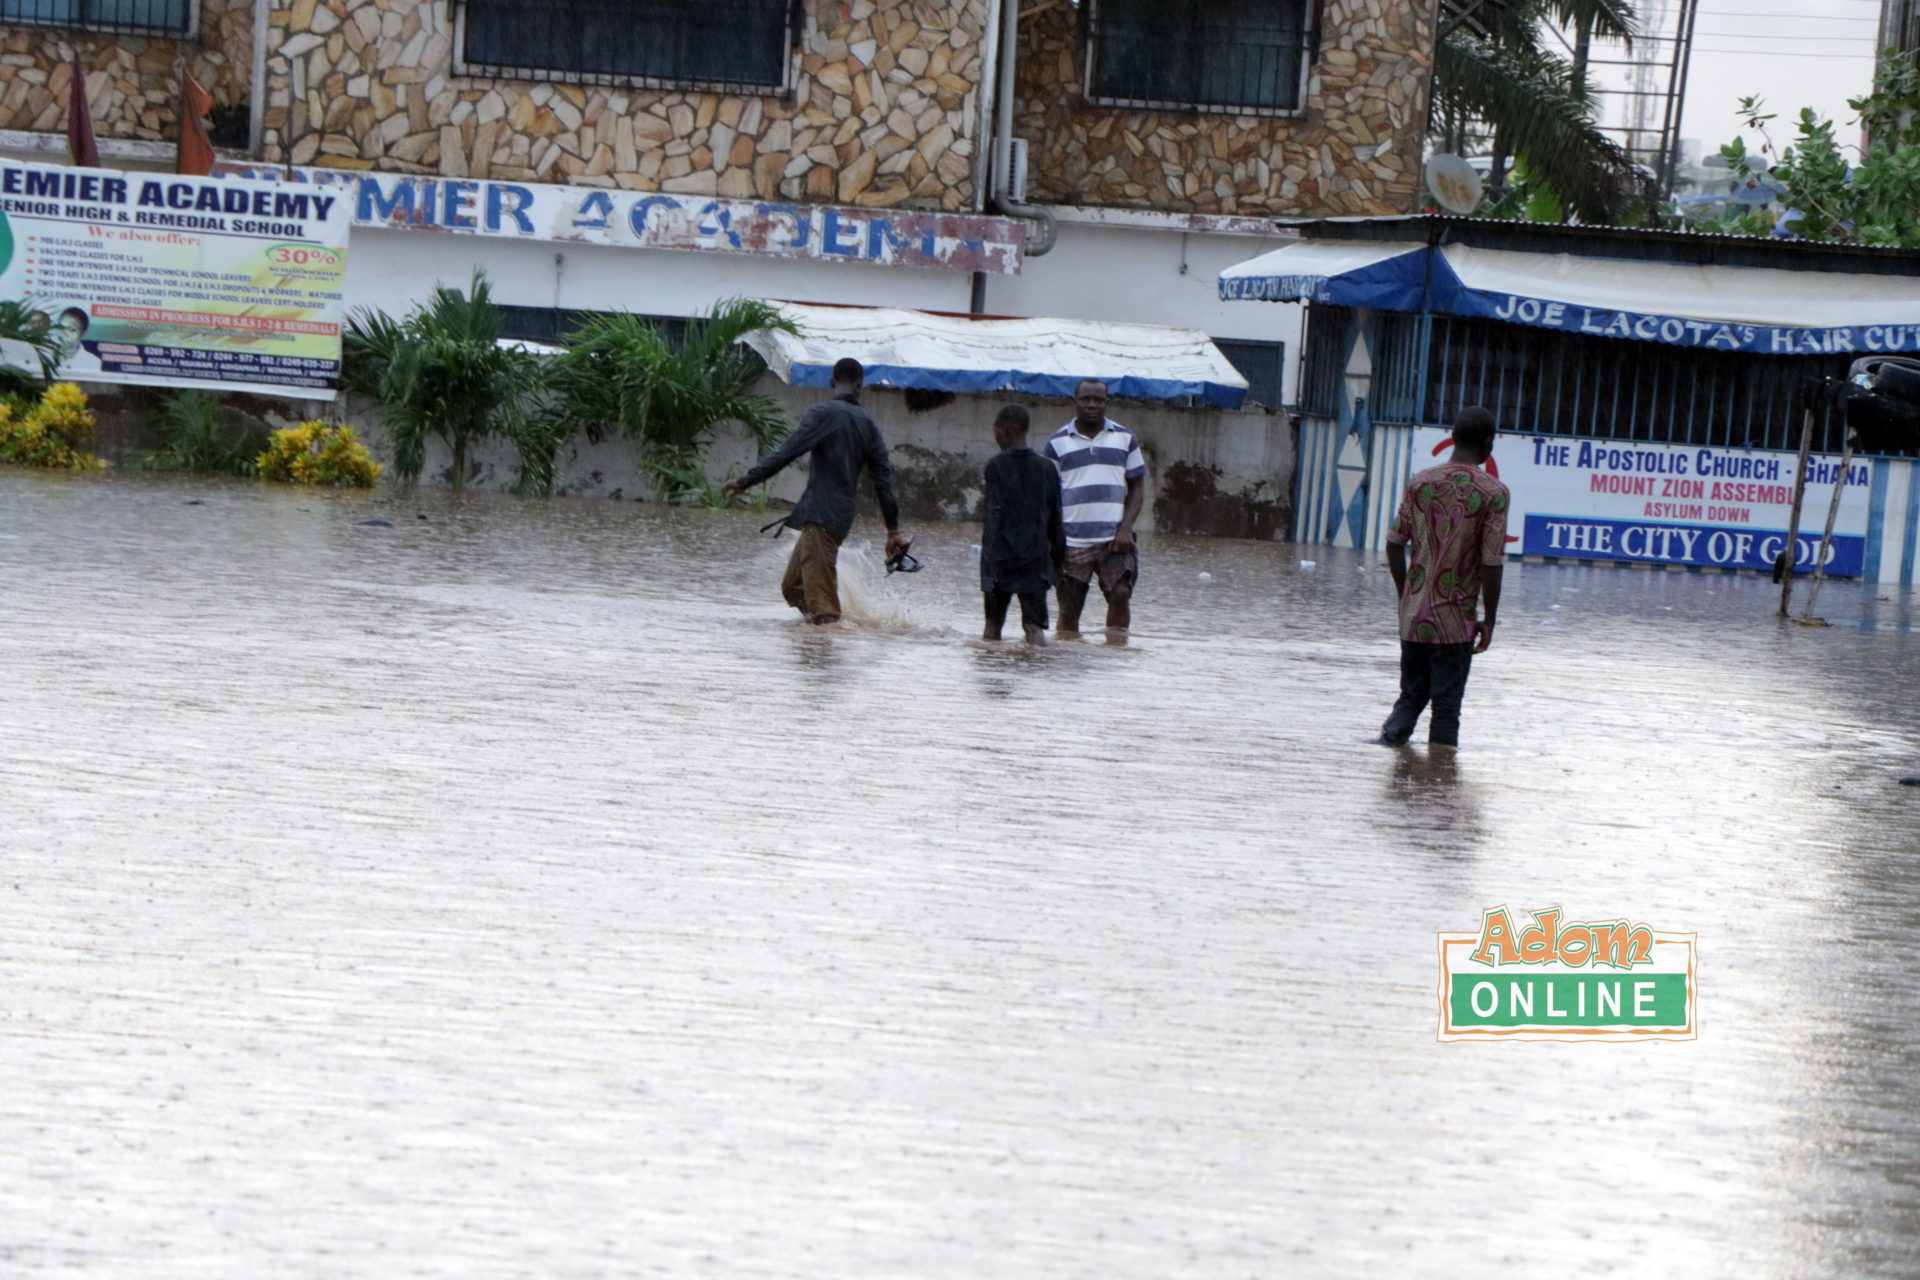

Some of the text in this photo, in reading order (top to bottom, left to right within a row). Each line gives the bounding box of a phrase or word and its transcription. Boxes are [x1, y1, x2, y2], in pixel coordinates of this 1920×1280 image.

[3, 168, 335, 221] EMIER ACADEMY
[65, 203, 111, 221] HIGH
[117, 211, 129, 222] &
[135, 211, 226, 231] REMEDIAL
[232, 219, 305, 237] SCHOOL
[74, 240, 104, 248] CLASSES
[88, 226, 201, 246] We also offer:
[40, 248, 77, 257] VACATION
[79, 251, 108, 259] CLASSES
[110, 253, 124, 261] FOR
[275, 248, 335, 265] 30%
[56, 259, 74, 267] YEAR
[77, 261, 113, 270] INTENSIVE
[150, 267, 189, 277] TECHNICAL
[191, 271, 218, 279] SCHOOL
[221, 273, 251, 282] LEAVERS
[38, 279, 54, 287] TWO
[56, 280, 78, 289] YEARS
[81, 282, 116, 292] INTENSIVE
[137, 287, 166, 296] CLASSES
[184, 291, 209, 300] MIDDLE
[212, 293, 240, 302] SCHOOL
[242, 296, 272, 305] LEAVERS
[57, 270, 79, 278] YEARS
[100, 274, 131, 283] EVENING
[133, 276, 161, 285] SCHOOL
[163, 279, 177, 287] FOR
[269, 288, 302, 297] WORKERS
[308, 291, 342, 300] MATURED
[55, 291, 87, 300] EVENING
[96, 294, 131, 304] WEEKEND
[133, 298, 162, 306] CLASSES
[96, 305, 146, 319] ADMISSION
[150, 310, 159, 320] IN
[161, 311, 210, 324] PROGRESS
[212, 315, 231, 326] FOR
[284, 321, 336, 334] REMEDIALS
[1495, 296, 1566, 326] JOE
[1771, 328, 1855, 352] HAIR
[147, 357, 172, 365] ACCRA
[1533, 438, 1569, 467] THE
[1577, 441, 1688, 475] APOSTOLIC
[1696, 449, 1779, 481] CHURCH
[1803, 456, 1868, 487] GHANA
[1590, 474, 1805, 506] MOUNT ZION ASSEMBL
[1644, 502, 1750, 522] ASYLUM DOWN
[1546, 522, 1613, 553] THE
[1621, 526, 1702, 561] CITY
[1708, 531, 1753, 564] OF
